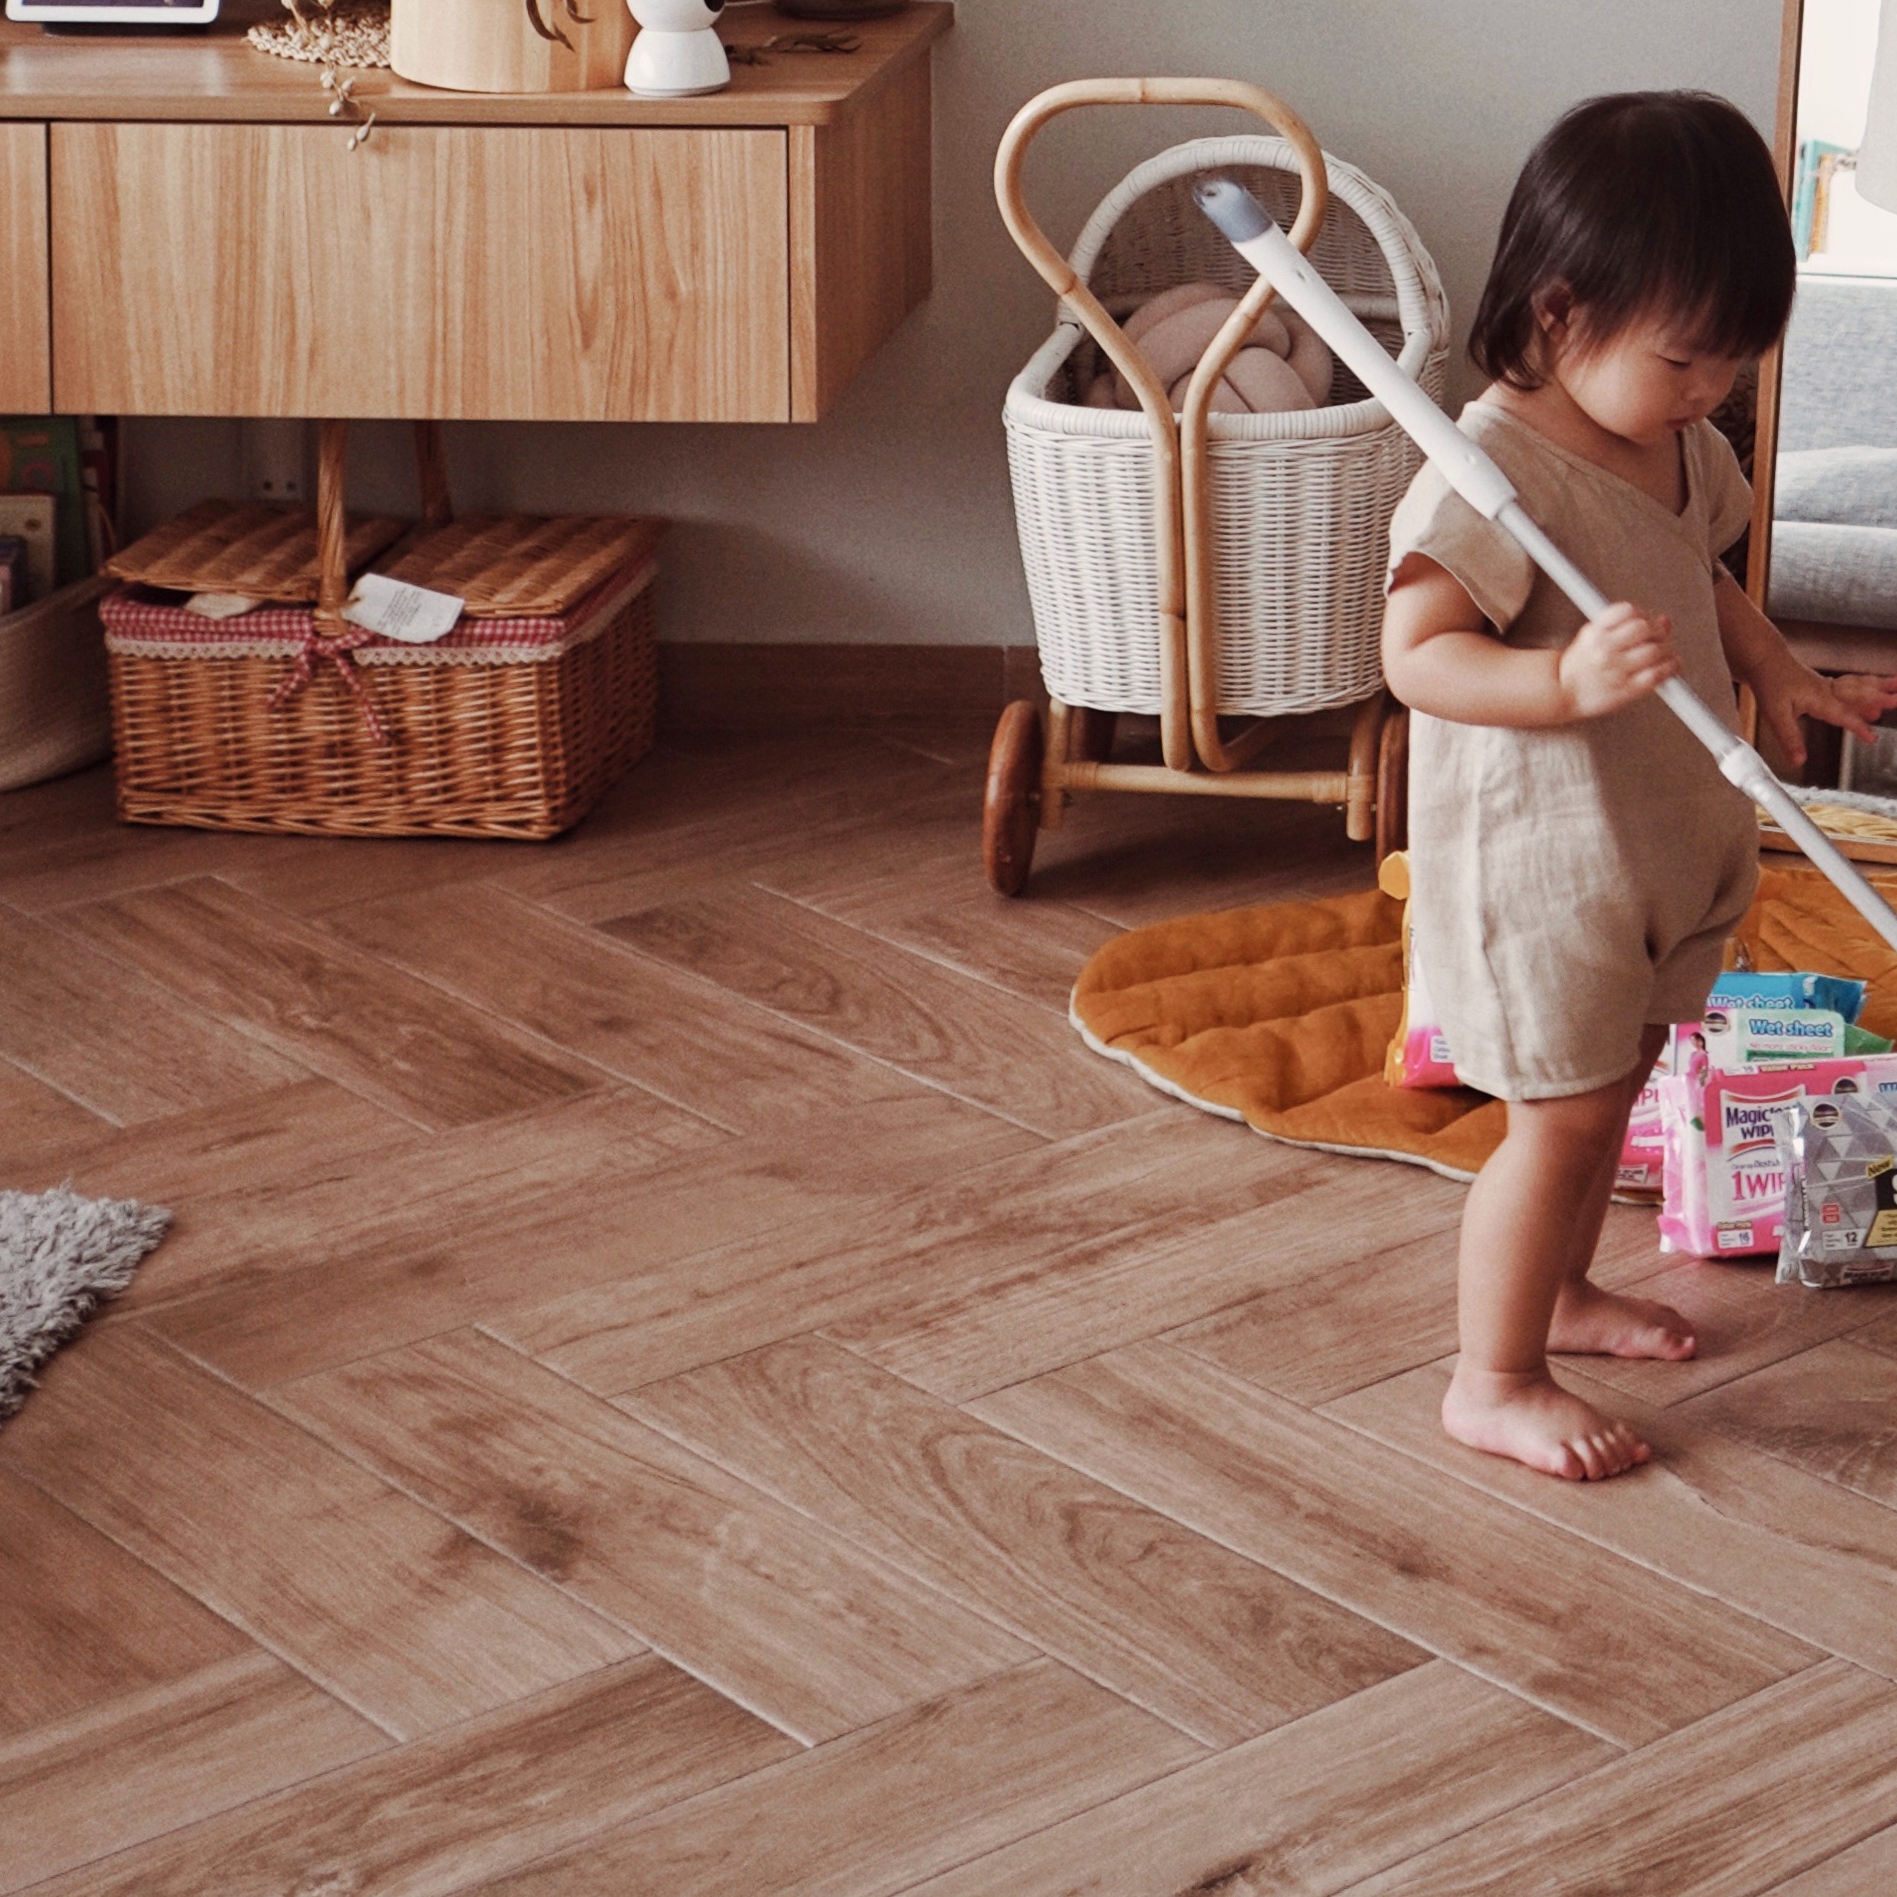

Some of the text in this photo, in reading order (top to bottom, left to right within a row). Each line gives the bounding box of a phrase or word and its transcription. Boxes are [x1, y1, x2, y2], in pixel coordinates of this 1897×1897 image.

[1749, 1018, 1834, 1038] Wet sheet
[1726, 1105, 1791, 1128] Magic
[1741, 1124, 1775, 1140] WIP
[1868, 1159, 1892, 1176] New
[1845, 1231, 1859, 1243] 12
